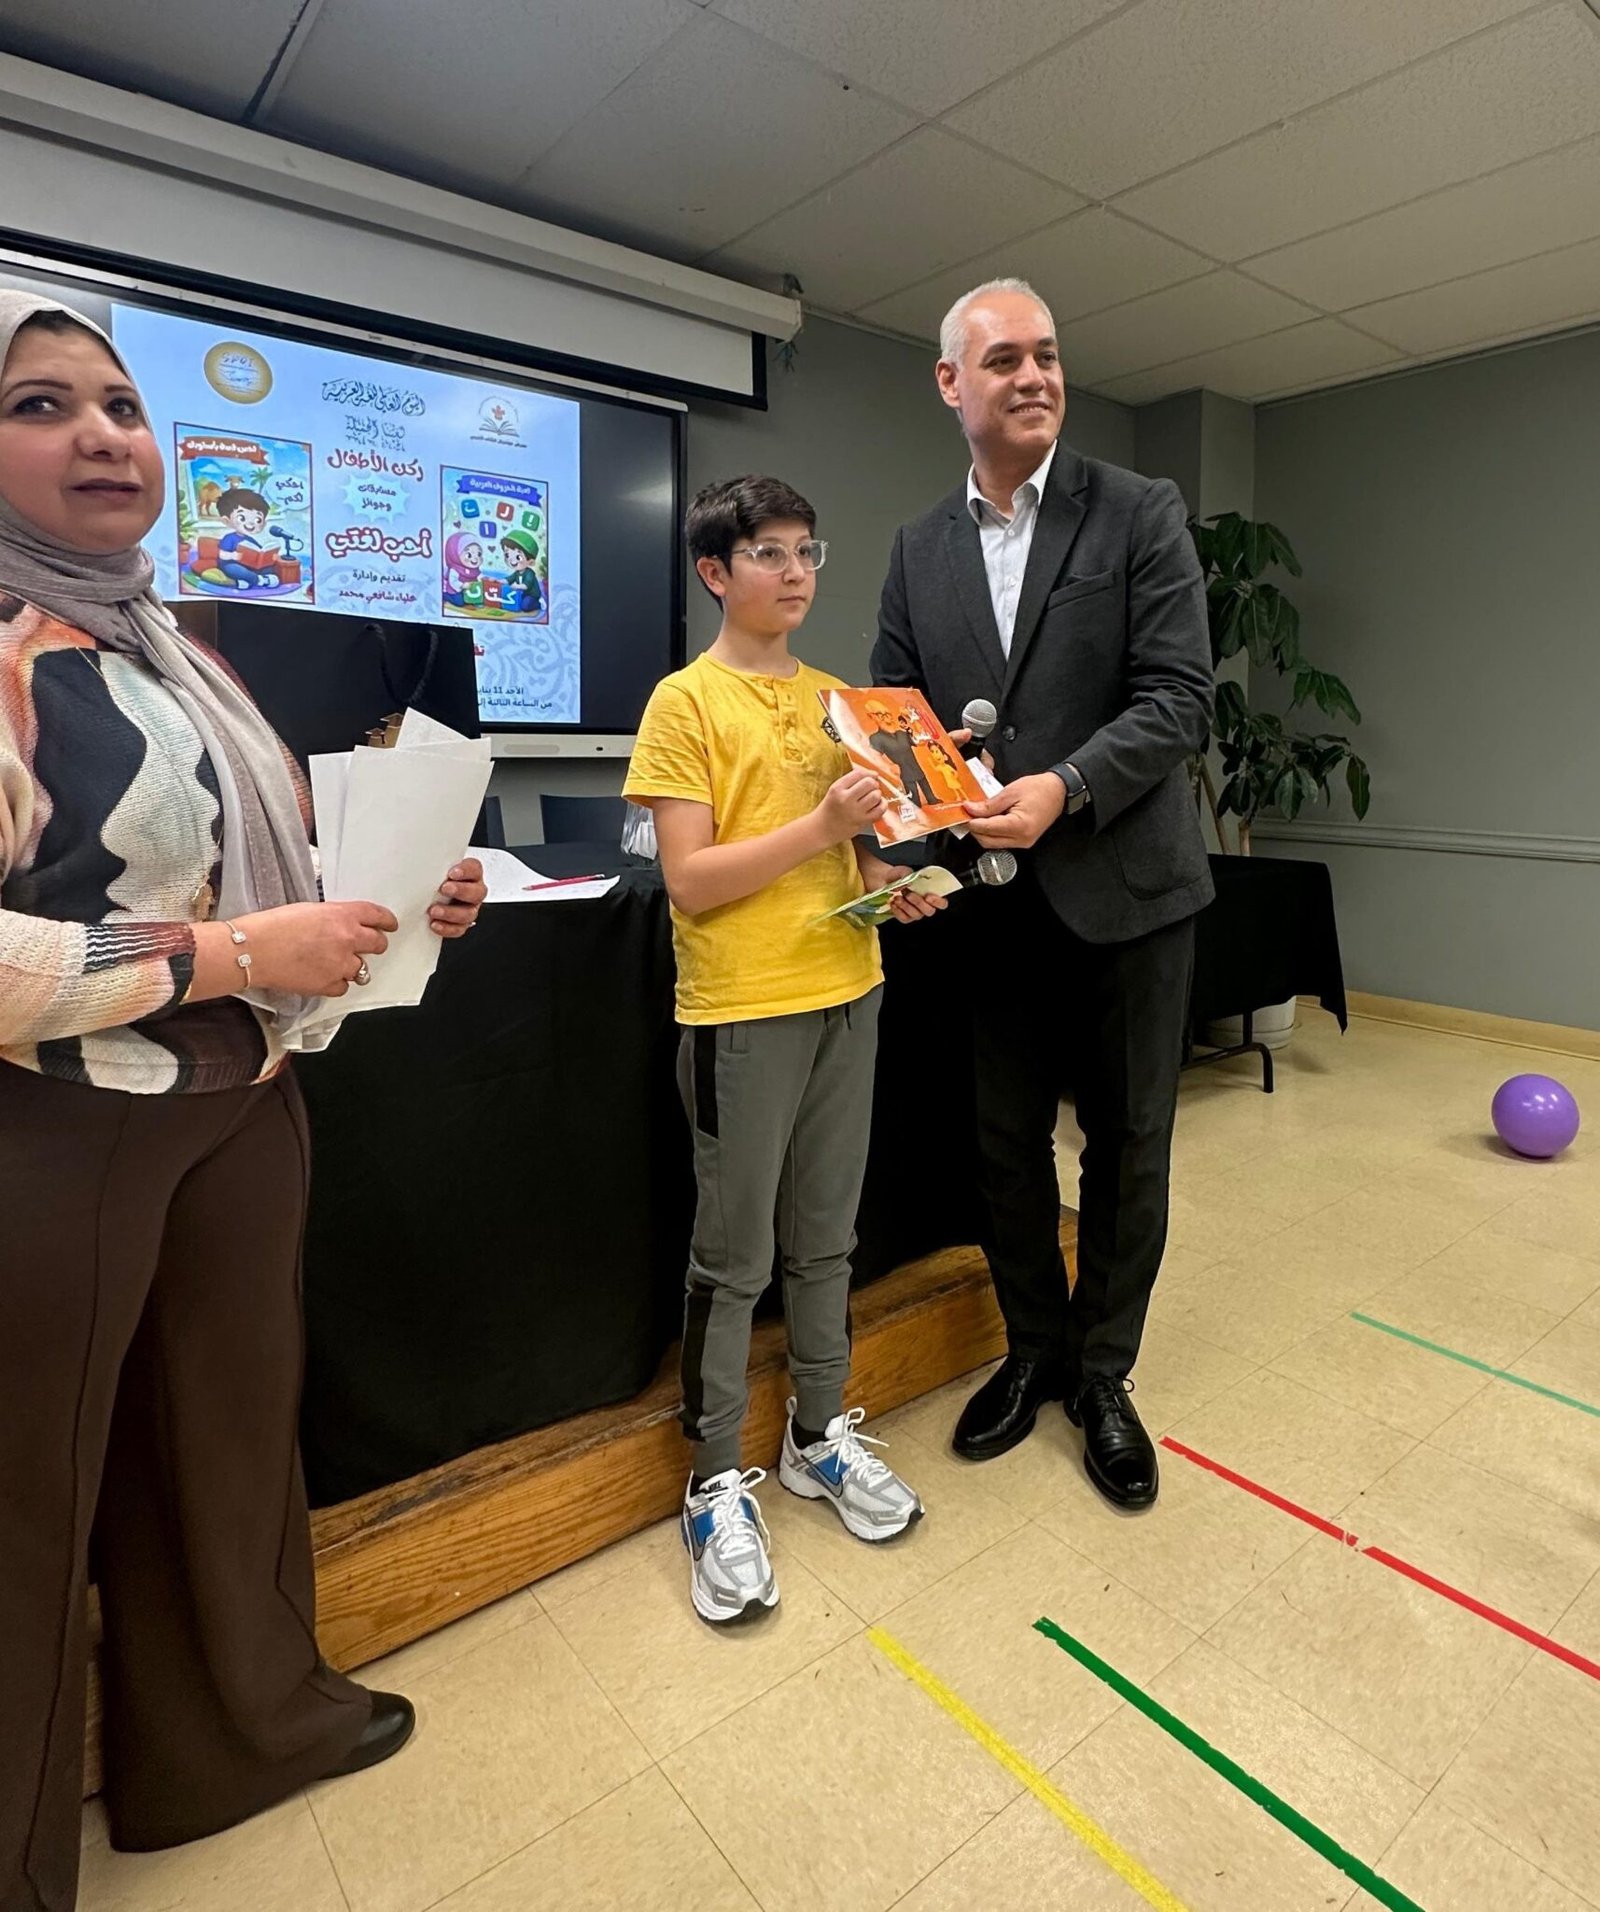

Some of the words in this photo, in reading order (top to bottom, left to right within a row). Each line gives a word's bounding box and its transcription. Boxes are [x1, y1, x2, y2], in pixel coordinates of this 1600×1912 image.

[326, 447, 389, 472] الأطفال
[391, 458, 424, 482] ركن
[325, 526, 384, 558] لغتي
[382, 527, 433, 562] أحب
[352, 568, 378, 583] وإدارة
[379, 573, 406, 584] تقديم
[338, 589, 365, 599] محمد
[365, 588, 395, 604] شافعي
[395, 591, 417, 604] علياء
[493, 685, 503, 694] 11
[511, 697, 539, 707] الساعة
[540, 700, 553, 709] من
